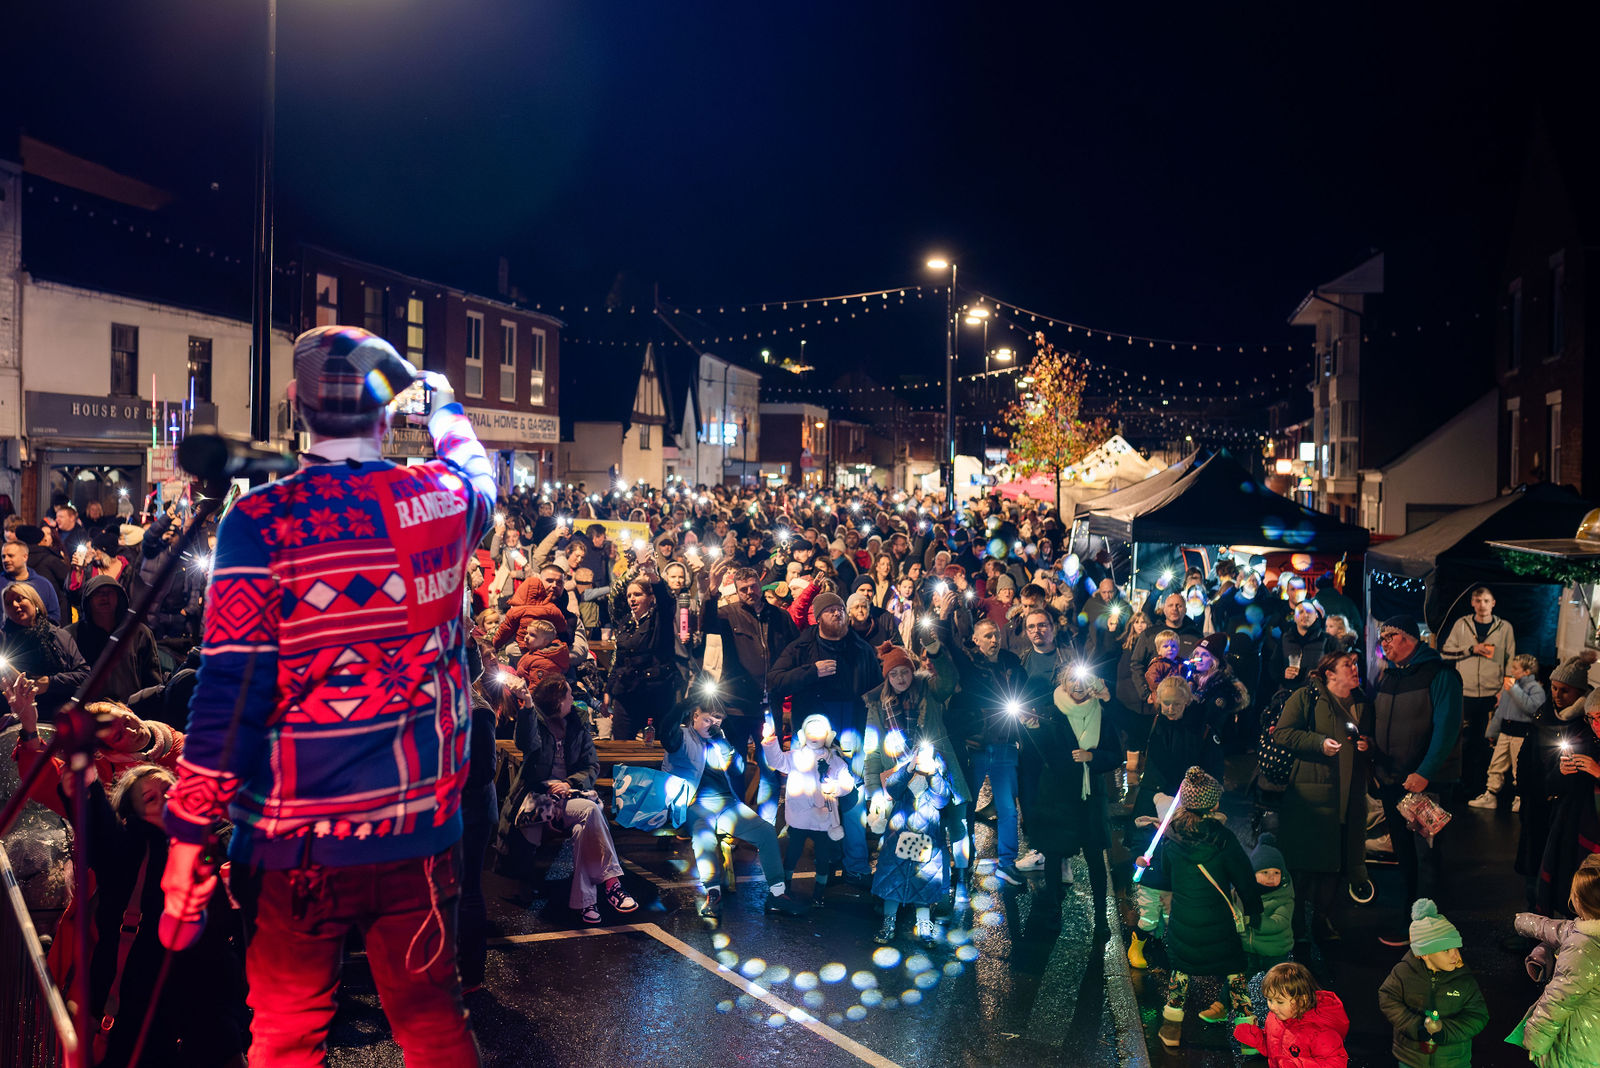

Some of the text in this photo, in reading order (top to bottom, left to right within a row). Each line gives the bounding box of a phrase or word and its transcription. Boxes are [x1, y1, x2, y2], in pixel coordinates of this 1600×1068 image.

[72, 402, 117, 418] HOUSE
[124, 406, 140, 420] OF
[493, 414, 519, 429] HOME
[520, 417, 526, 430] &
[528, 418, 557, 432] GARDEN
